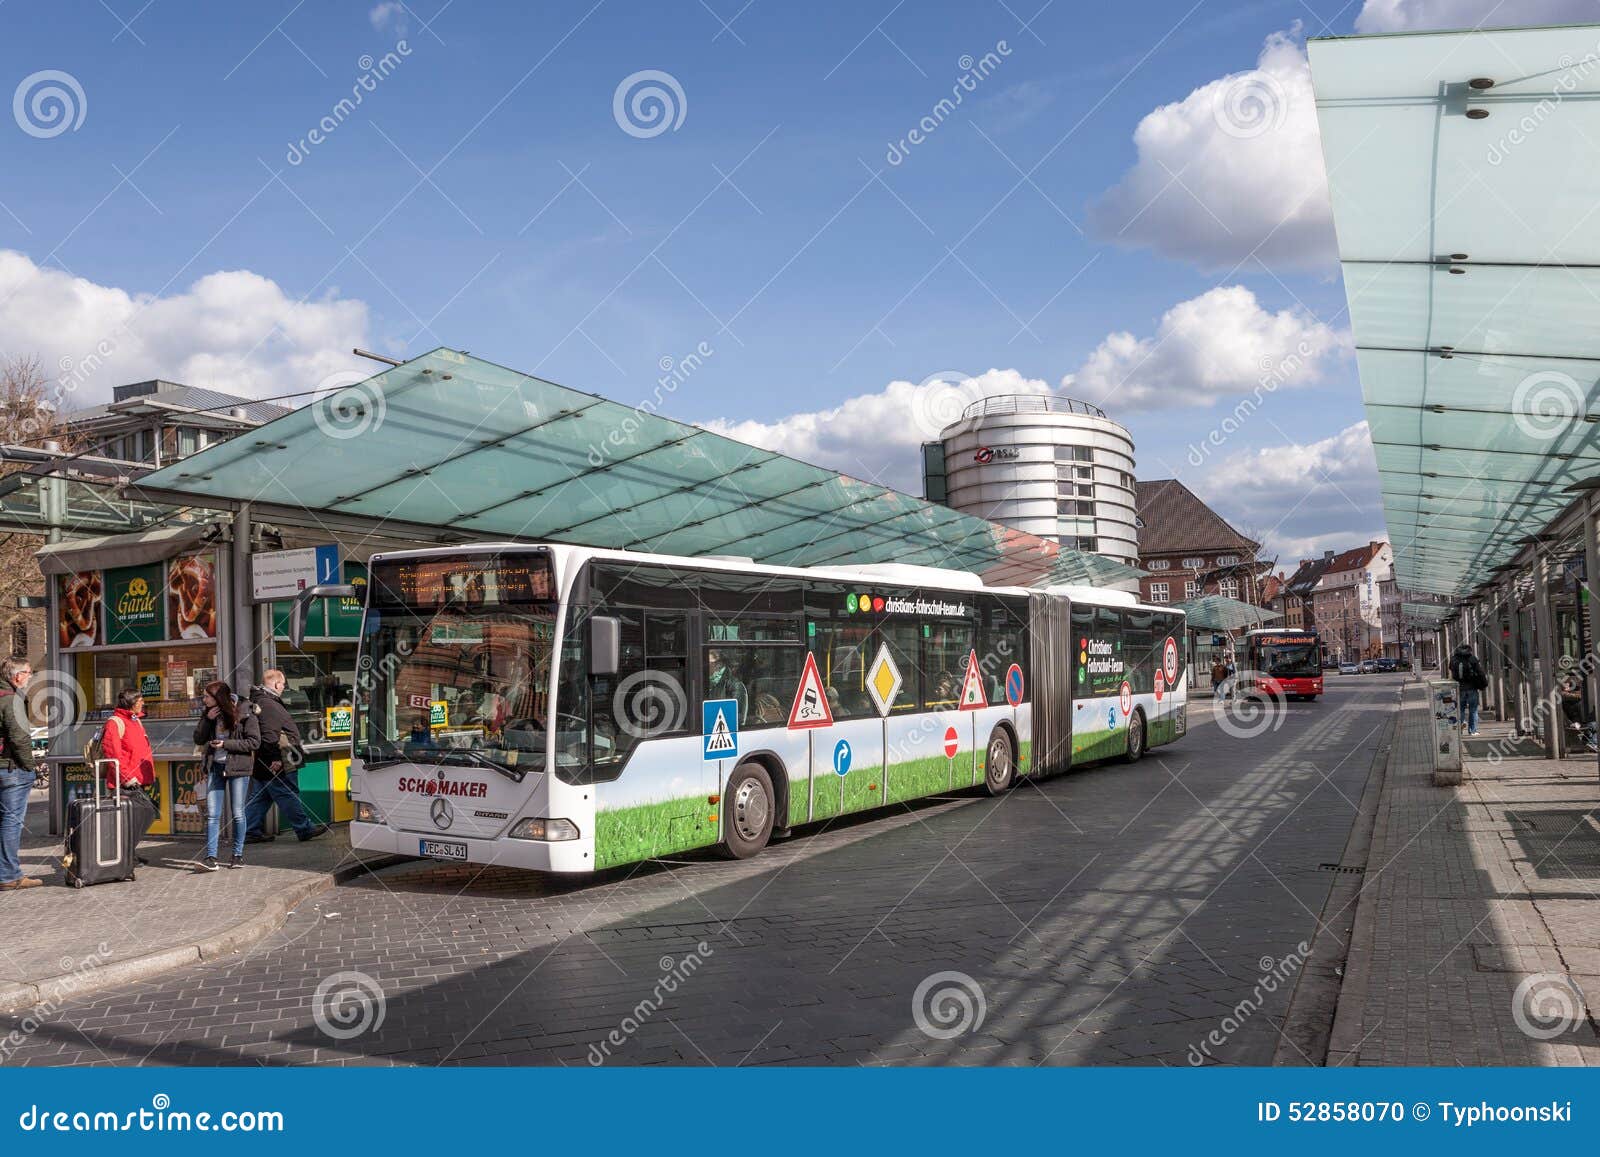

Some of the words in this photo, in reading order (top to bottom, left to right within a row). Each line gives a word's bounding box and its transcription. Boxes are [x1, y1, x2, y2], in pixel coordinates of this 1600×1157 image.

[118, 591, 154, 615] Garde
[885, 596, 966, 616] christians-fahrschul-team.de
[1088, 639, 1112, 655] Christians
[1087, 657, 1124, 673] Fahrschul-Team
[425, 842, 440, 855] VEC
[444, 844, 454, 856] SL
[455, 845, 465, 857] 61
